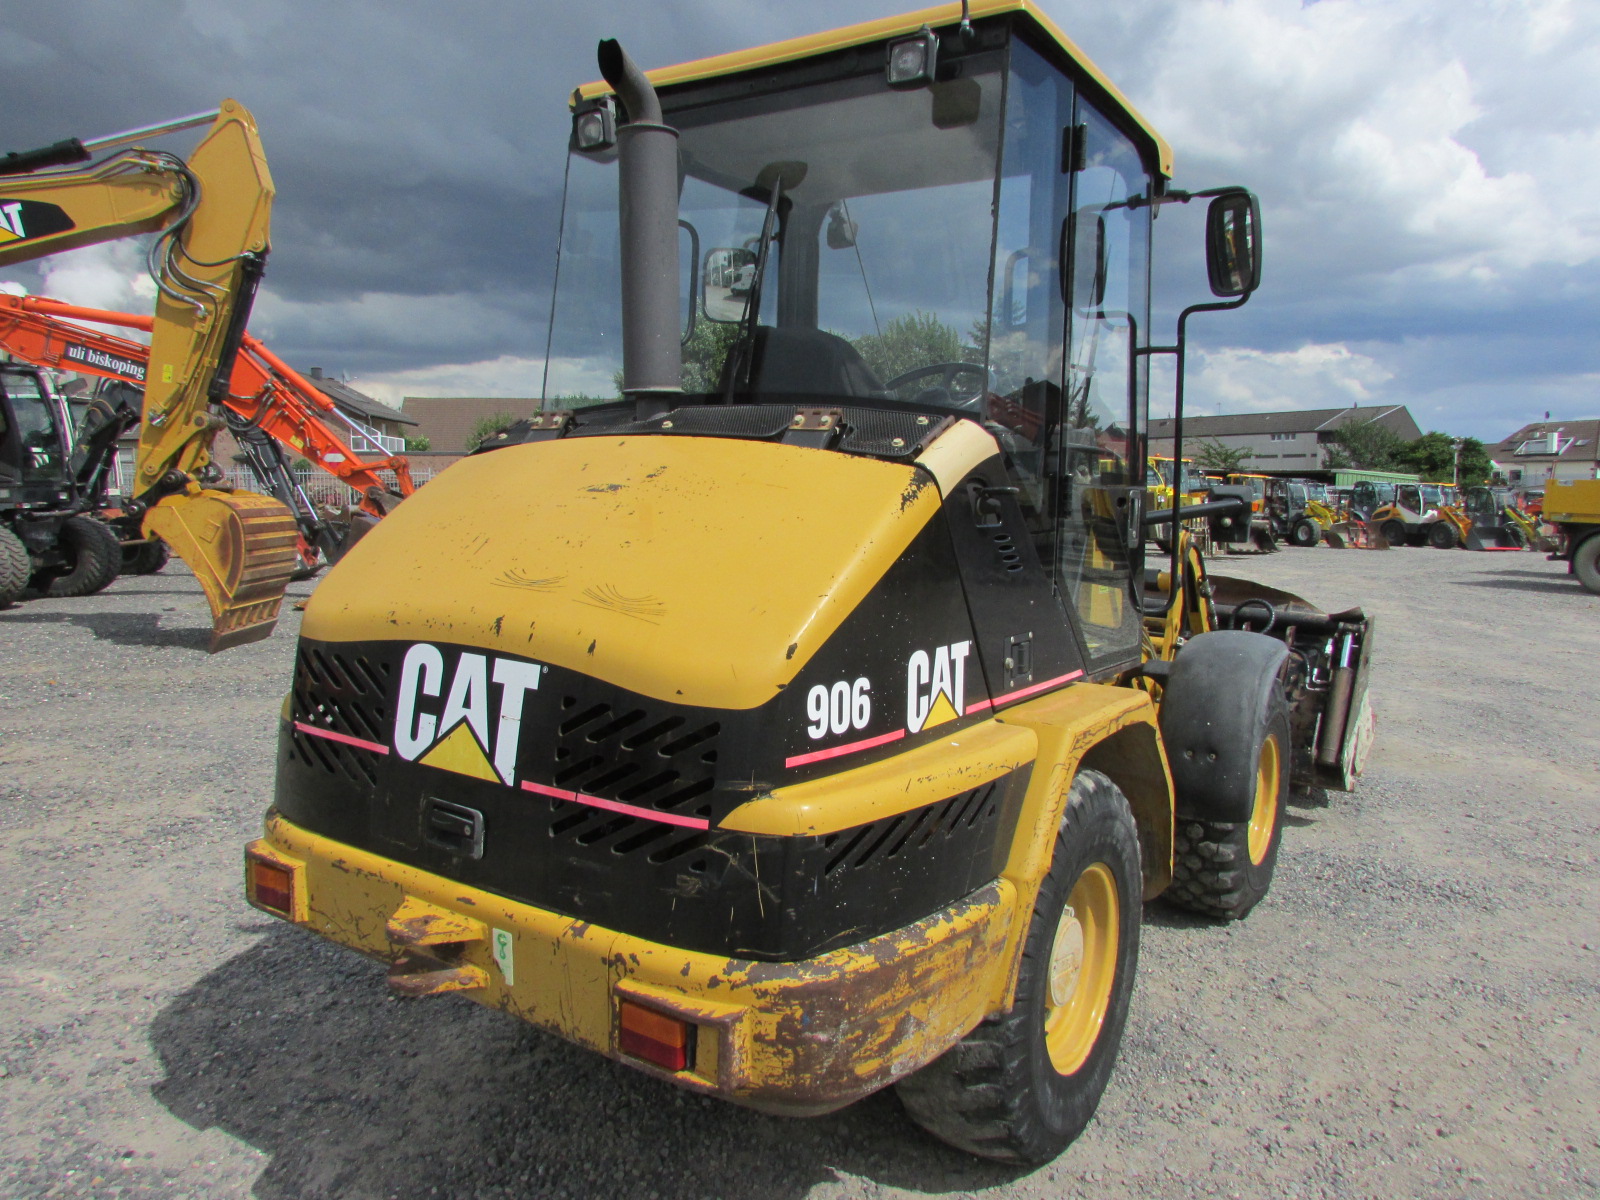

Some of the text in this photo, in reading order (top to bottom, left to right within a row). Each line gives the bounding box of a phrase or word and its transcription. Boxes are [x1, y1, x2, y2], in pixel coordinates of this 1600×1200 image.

[69, 346, 146, 380] uli biskoping
[394, 643, 541, 787] CAT
[807, 677, 871, 740] 906
[907, 640, 970, 733] CAT
